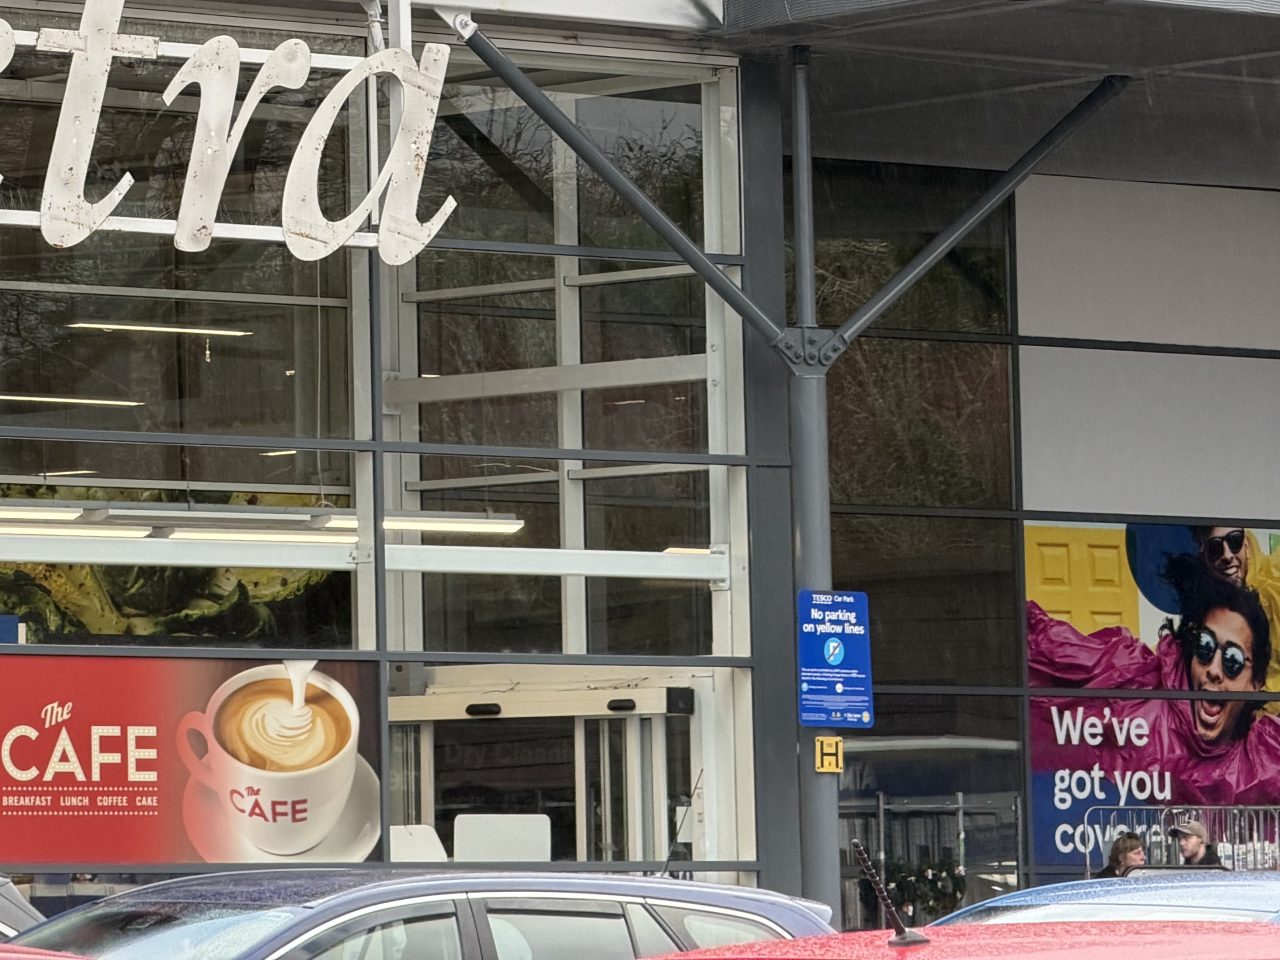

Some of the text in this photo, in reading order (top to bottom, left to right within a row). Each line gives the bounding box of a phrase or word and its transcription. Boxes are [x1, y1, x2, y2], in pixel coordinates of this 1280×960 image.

[802, 622, 865, 636] on yellow lines
[811, 608, 857, 624] No parking
[40, 700, 73, 729] The
[1050, 706, 1149, 747] We've
[1, 725, 158, 782] CAFE
[820, 740, 839, 769] H
[1053, 762, 1172, 810] got you
[2, 796, 159, 807] BREAKFAST LUNCH COFFEE CAKE
[229, 788, 308, 823] CAFE
